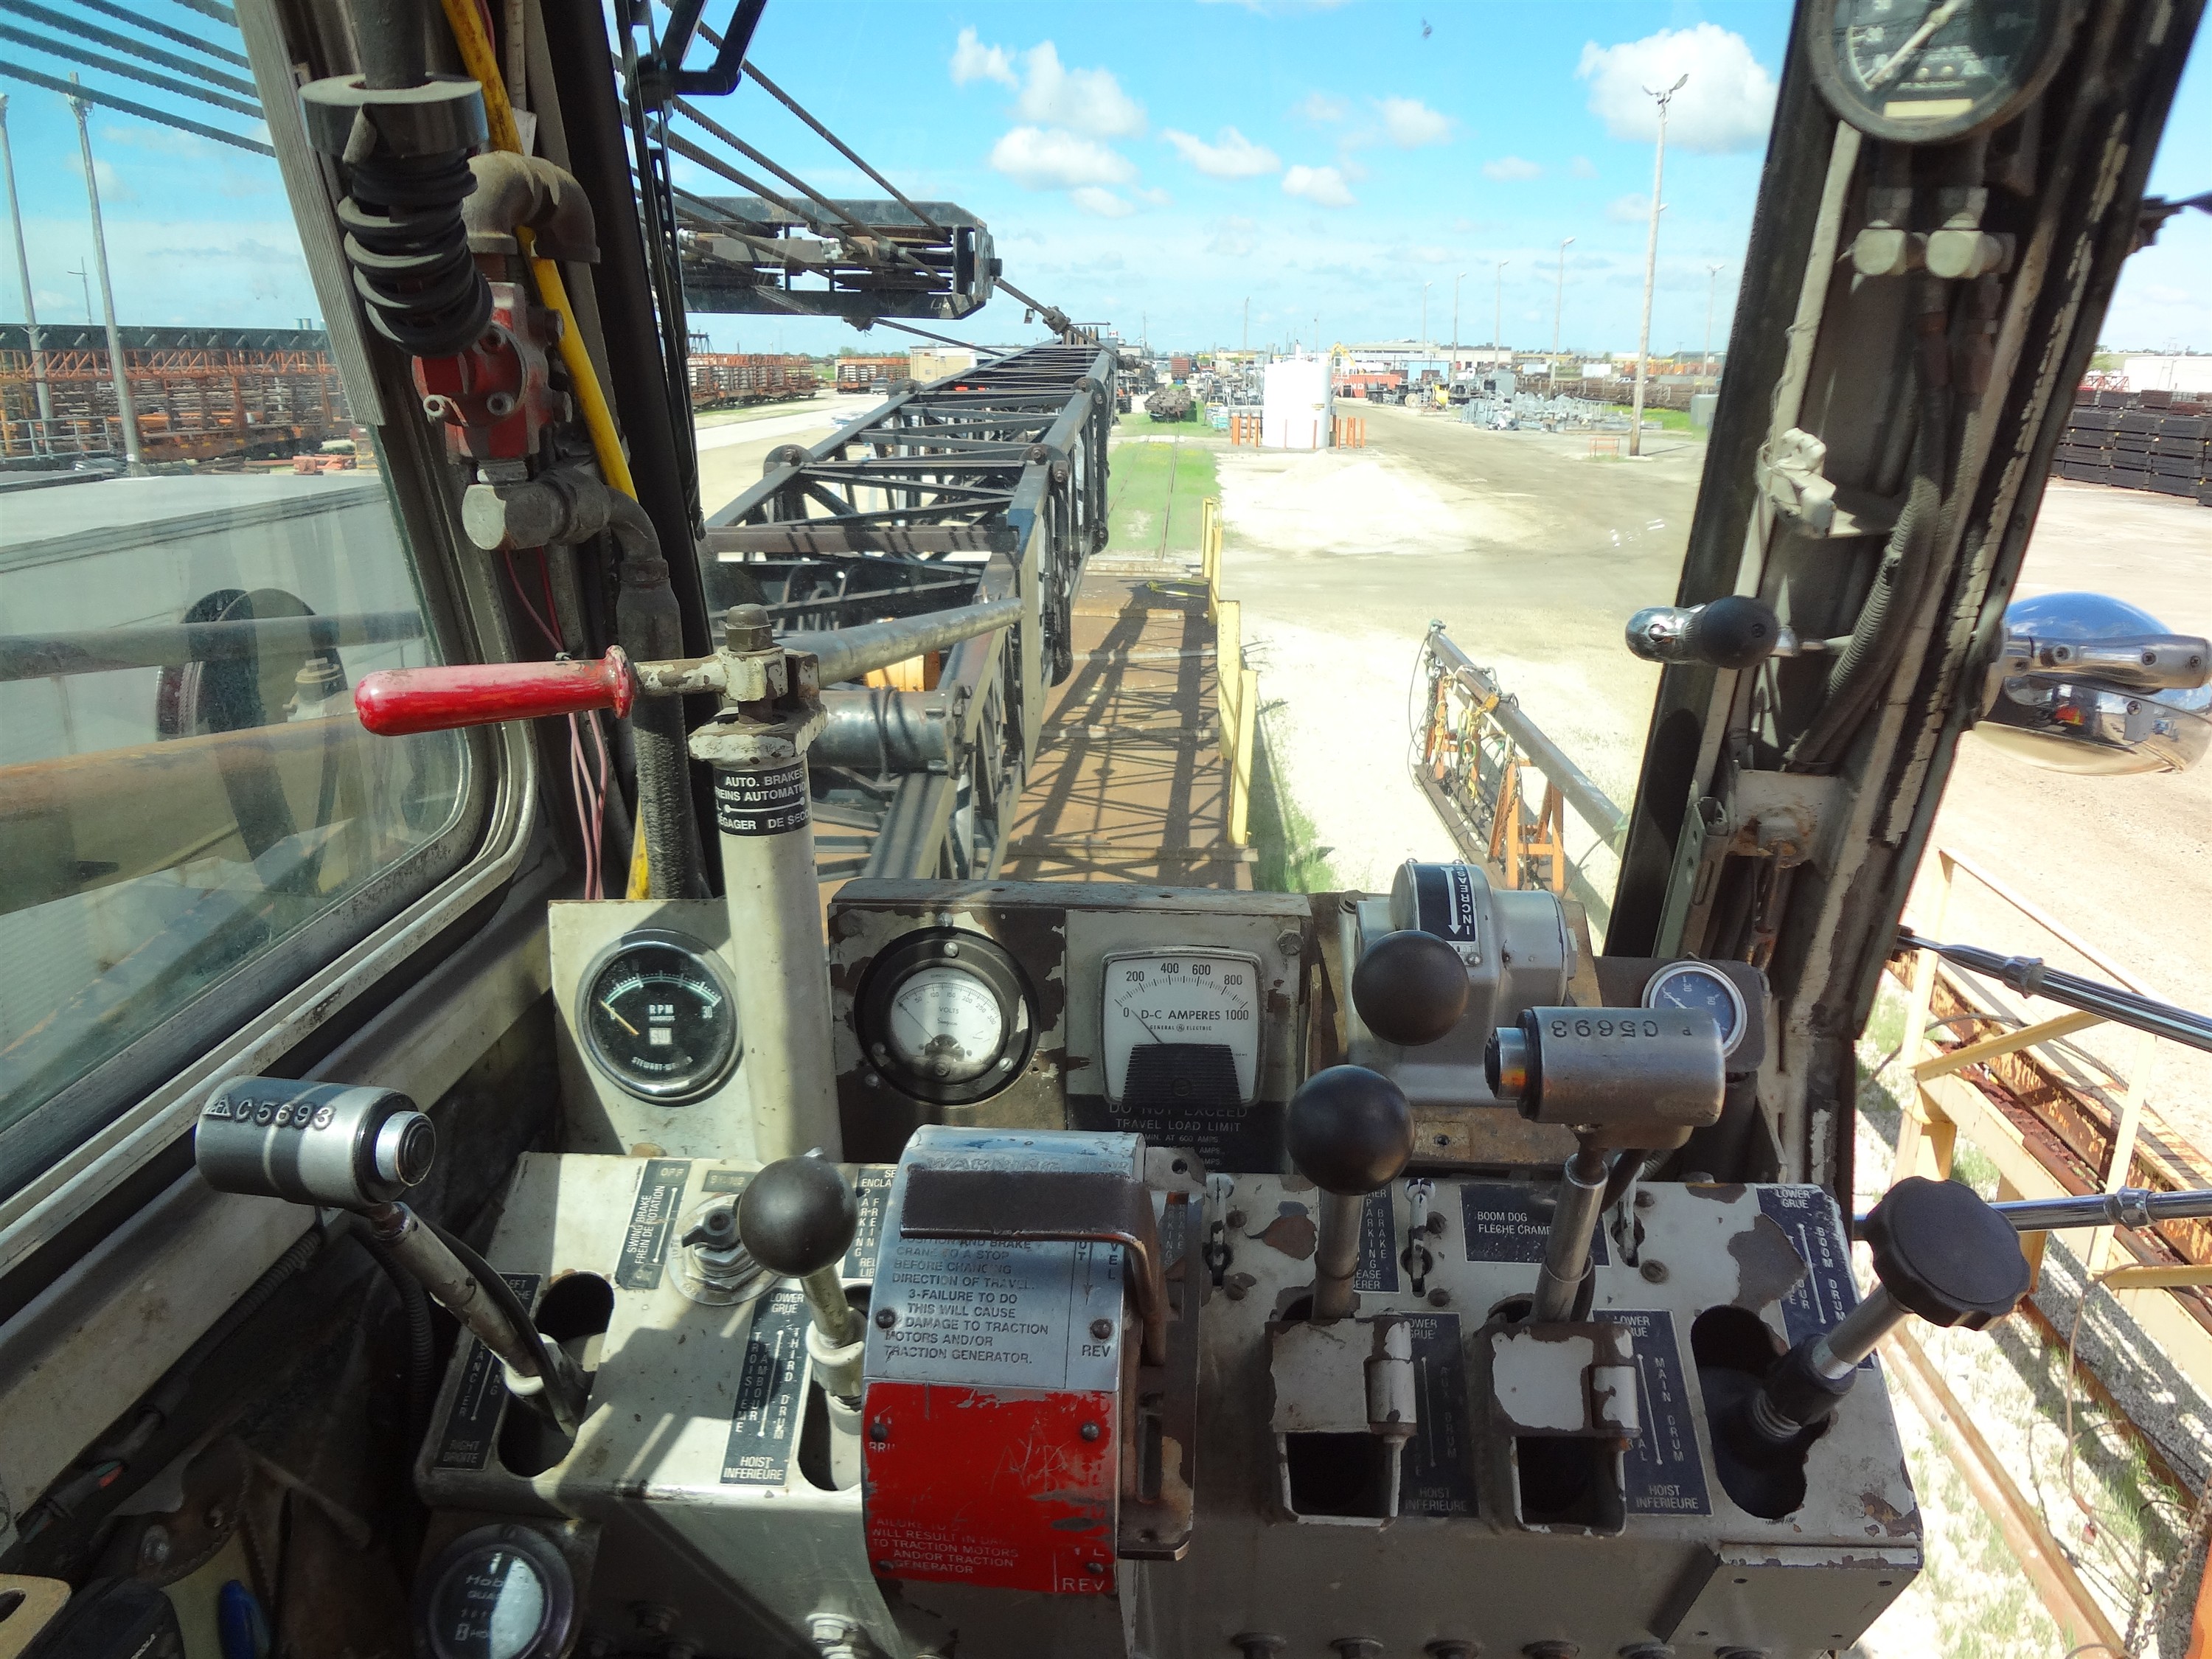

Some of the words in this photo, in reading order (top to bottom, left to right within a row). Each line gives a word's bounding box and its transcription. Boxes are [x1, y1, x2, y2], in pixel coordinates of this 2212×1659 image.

[725, 776, 759, 787] AUTO.
[764, 768, 804, 786] BRAKES
[718, 813, 757, 830] ÉGAGER
[768, 818, 785, 829] DE
[1126, 971, 1144, 982] 200
[1161, 963, 1180, 974] 400
[1192, 964, 1211, 975] 600
[1224, 974, 1242, 985] 800
[1683, 983, 1692, 992] 30
[1707, 995, 1716, 1006] 60
[649, 1005, 674, 1014] RPM
[702, 1006, 713, 1018] 30
[939, 1006, 959, 1015] VOLTS
[961, 995, 973, 1004] 200
[975, 1003, 987, 1013] 250
[987, 1015, 997, 1026] 300
[1123, 1007, 1130, 1018] 0
[1141, 1009, 1162, 1019] D-C
[1168, 1010, 1220, 1020] AMPERES
[1225, 1009, 1249, 1020] 1000
[1551, 1020, 1659, 1038] C5693
[235, 1097, 335, 1130] C5693
[1116, 1118, 1161, 1130] TRAVEL
[1169, 1120, 1201, 1131] LOAD
[1208, 1122, 1242, 1132] LIMIT
[1204, 1158, 1222, 1166] MPS.
[661, 1167, 684, 1178] OFF
[1776, 1189, 1811, 1199] LOWER
[647, 1185, 665, 1222] ROTATION
[1782, 1198, 1809, 1208] GRUE
[626, 1225, 643, 1253] SWING
[635, 1195, 652, 1222] BRAKE
[866, 1198, 880, 1246] FREIN
[1478, 1211, 1505, 1221] BOOM
[1508, 1212, 1528, 1222] DOG
[643, 1226, 654, 1237] DE
[1366, 1198, 1377, 1268] PARKING
[1377, 1208, 1386, 1259] BRAKE
[635, 1239, 650, 1264] FREIN
[976, 1250, 1009, 1260] STOP
[1816, 1227, 1834, 1268] BOOM
[894, 1258, 942, 1271] BEFORE
[892, 1273, 958, 1286] DIRECTION
[962, 1276, 980, 1286] OF
[770, 1293, 804, 1303] LOWER
[908, 1288, 973, 1302] 3-FAILURE
[978, 1293, 995, 1304] TO
[1000, 1293, 1018, 1304] DO
[1829, 1279, 1846, 1321] DRUM
[772, 1304, 798, 1314] GRUE
[908, 1302, 935, 1314] THIS
[939, 1304, 969, 1316] WILL
[974, 1307, 1016, 1318] CAUSE
[905, 1317, 959, 1330] DAMAGE
[964, 1320, 981, 1331] TO
[985, 1321, 1048, 1335] TRACTION
[886, 1329, 939, 1343] MOTORS
[942, 1334, 994, 1346] AND/OR
[784, 1327, 800, 1382] THIRD
[885, 1344, 947, 1360] TRACTION
[951, 1349, 1032, 1364] GENERATOR.
[1082, 1344, 1111, 1357] REV
[1655, 1357, 1672, 1402] MAIN
[775, 1394, 790, 1439] DRUM
[1667, 1415, 1684, 1462] DRUM
[740, 1456, 772, 1469] HOIST
[1649, 1484, 1680, 1496] HOIST
[1635, 1497, 1699, 1509] INFERIEURE
[872, 1528, 901, 1538] WILL
[906, 1530, 956, 1543] RESULT
[873, 1539, 888, 1547] TO
[893, 1540, 957, 1553] TRACTION
[963, 1545, 1019, 1558] MOTORS
[894, 1550, 943, 1561] AND/OR
[947, 1554, 1013, 1567] TRACTION
[894, 1559, 973, 1573] GENERATOR
[1062, 1578, 1105, 1591] REV
